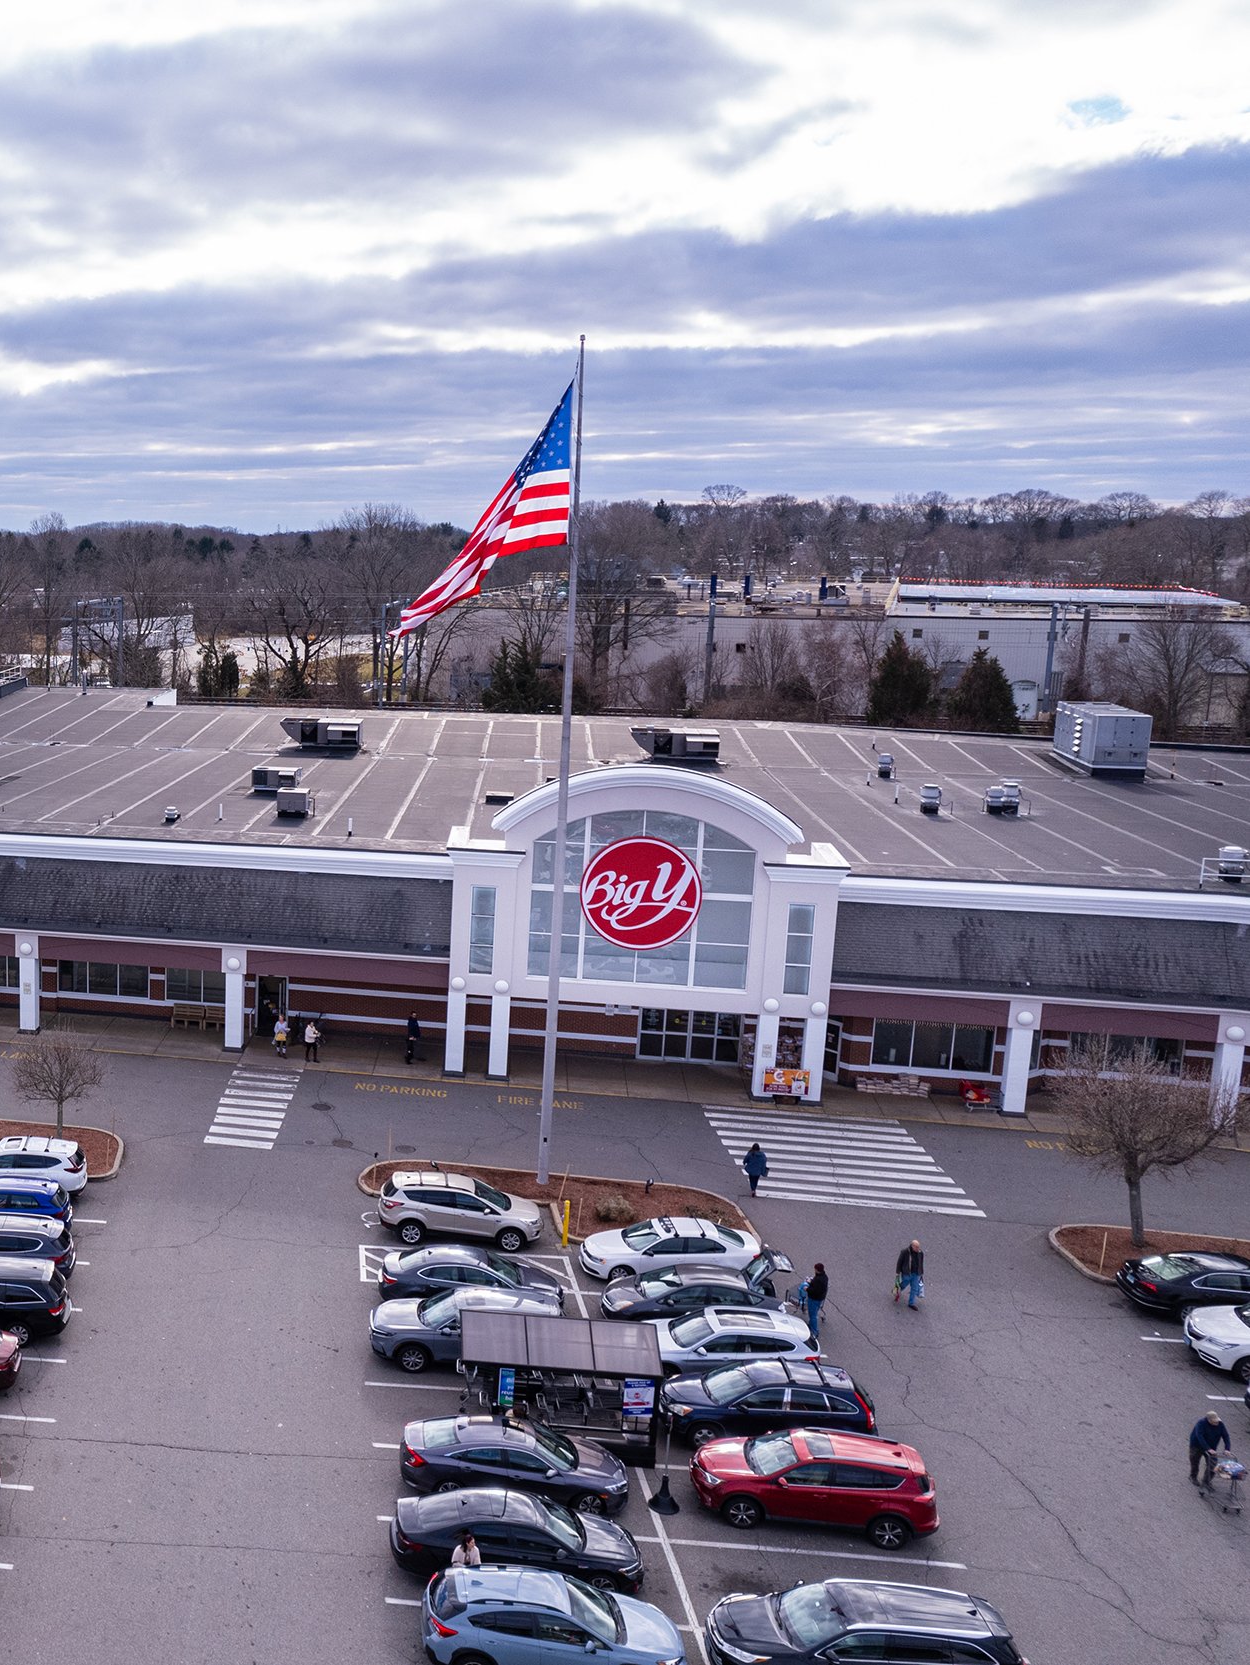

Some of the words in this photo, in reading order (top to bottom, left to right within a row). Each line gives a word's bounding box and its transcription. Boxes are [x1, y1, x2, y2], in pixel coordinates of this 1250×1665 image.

[584, 870, 650, 920] Big
[610, 861, 694, 930] Y
[355, 1082, 378, 1092] NO
[380, 1085, 447, 1098] PARKING
[497, 1095, 534, 1106] FIRE
